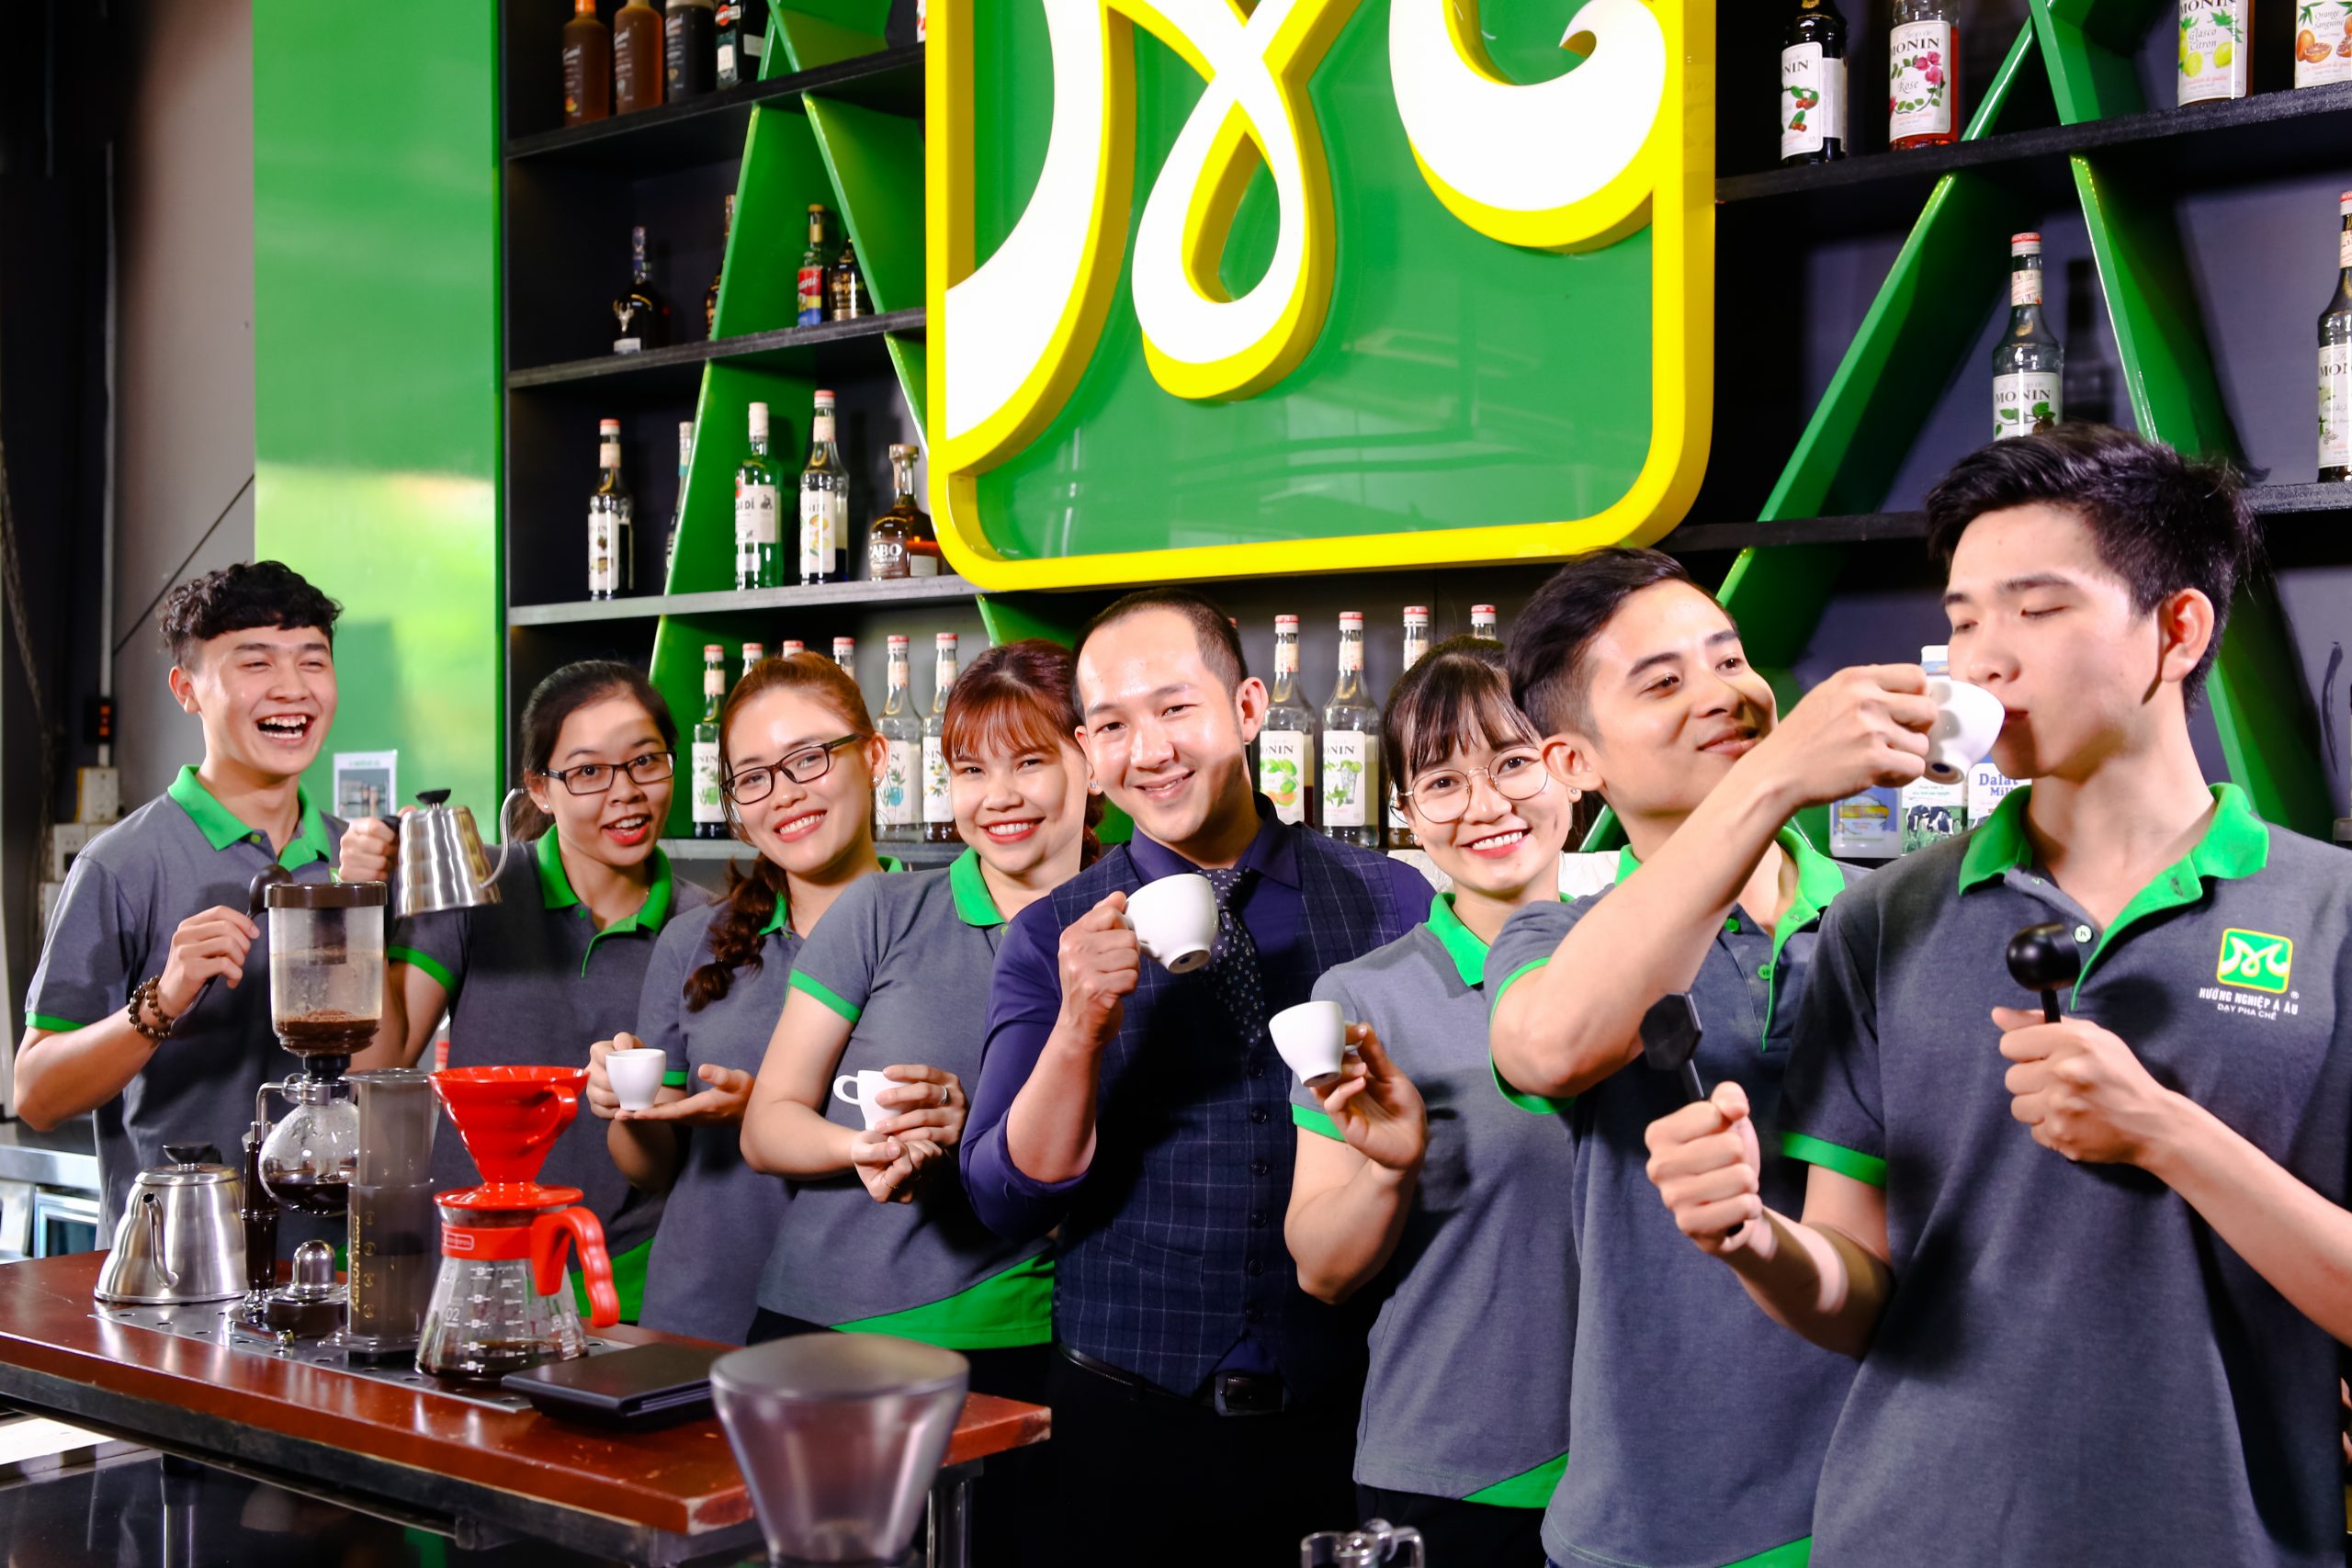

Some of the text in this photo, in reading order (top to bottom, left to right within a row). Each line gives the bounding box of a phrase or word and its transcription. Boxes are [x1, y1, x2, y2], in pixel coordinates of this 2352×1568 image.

[1784, 59, 1808, 73] NIN
[1898, 79, 1919, 94] Rose
[1996, 389, 2051, 404] MONIN
[1261, 744, 1294, 755] ONIN
[1324, 744, 1356, 755] ONIN
[1990, 786, 2014, 796] Mil
[2237, 1006, 2256, 1017] PHA
[445, 1307, 460, 1322] 02
